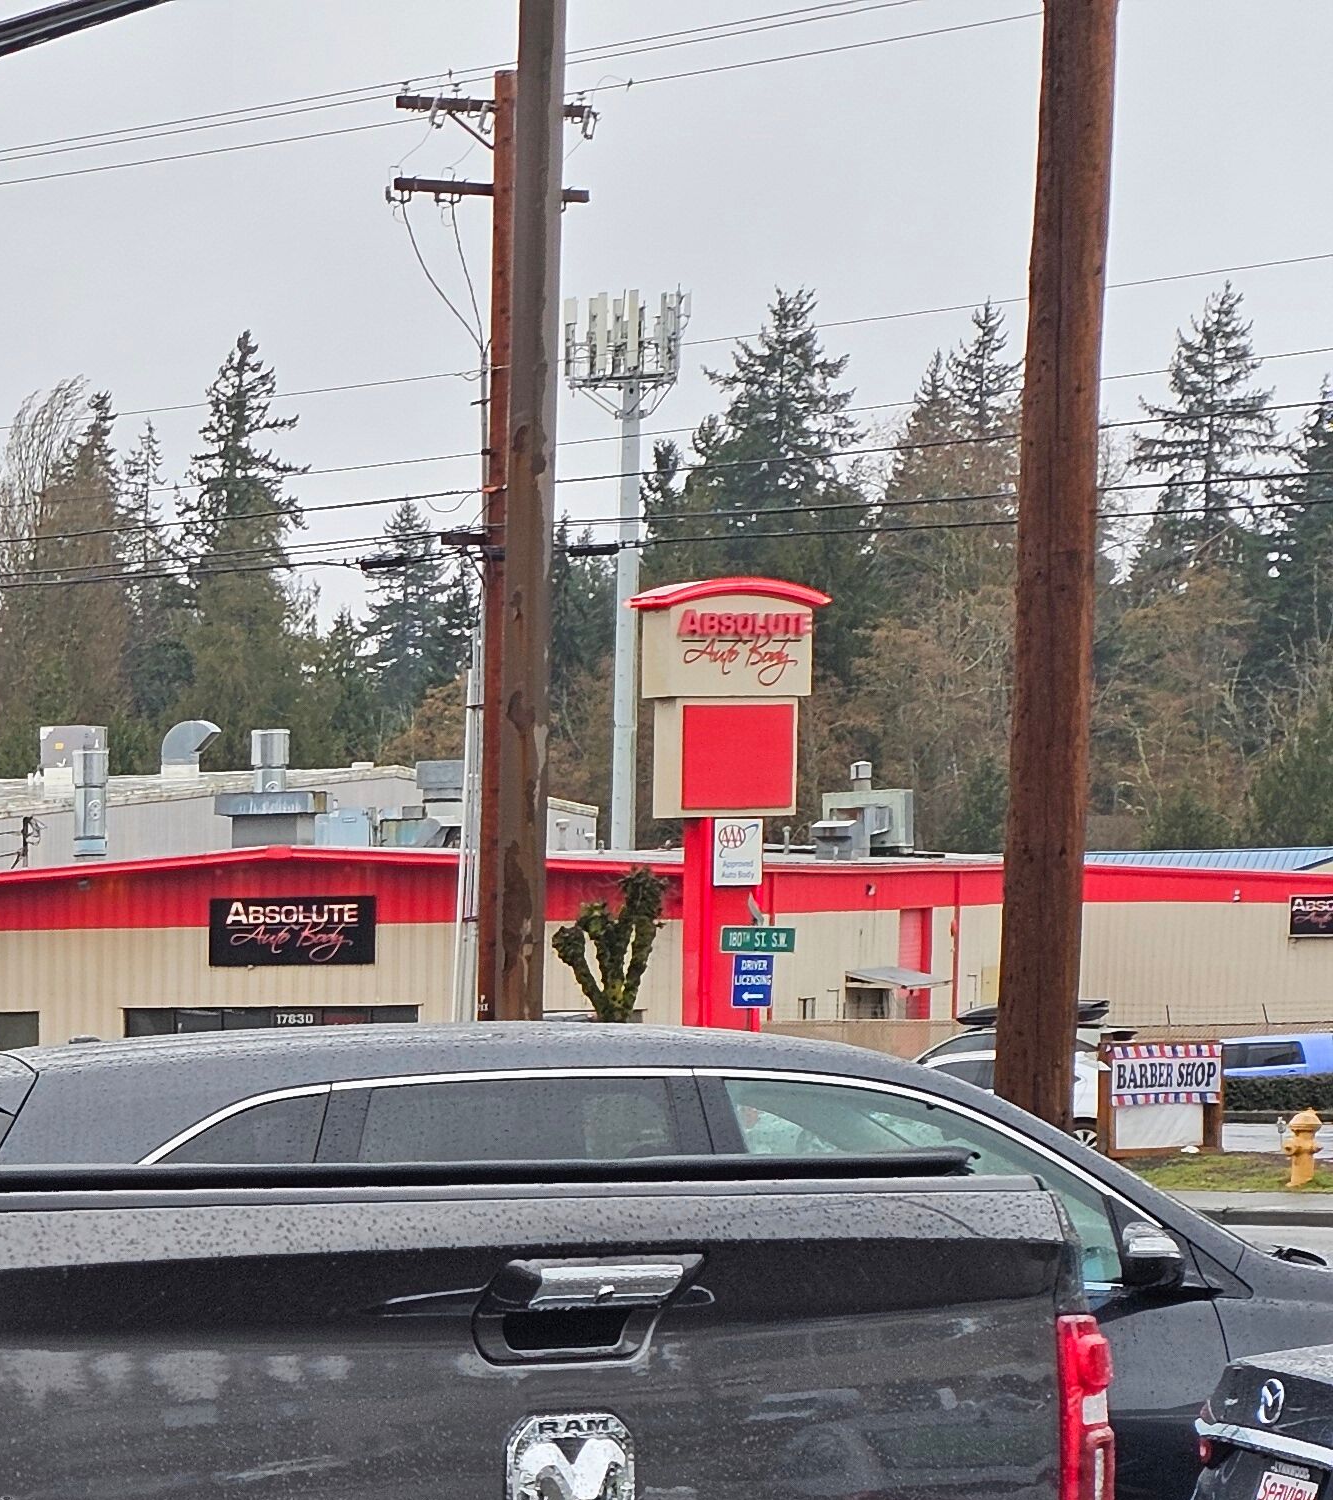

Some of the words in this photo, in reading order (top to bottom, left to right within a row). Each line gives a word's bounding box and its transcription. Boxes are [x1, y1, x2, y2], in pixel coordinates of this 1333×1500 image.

[677, 609, 813, 637] ABSOLUTE
[683, 636, 741, 675] Auto
[744, 633, 798, 686] Body
[226, 902, 359, 925] ABSOLUTE
[230, 924, 296, 954] Auto
[296, 921, 354, 963] Body
[740, 960, 768, 971] DRIVER
[734, 974, 772, 986] LICENSING
[1116, 1063, 1174, 1090] BARBER
[1176, 1061, 1217, 1088] SHOP
[537, 1417, 610, 1436] RAM
